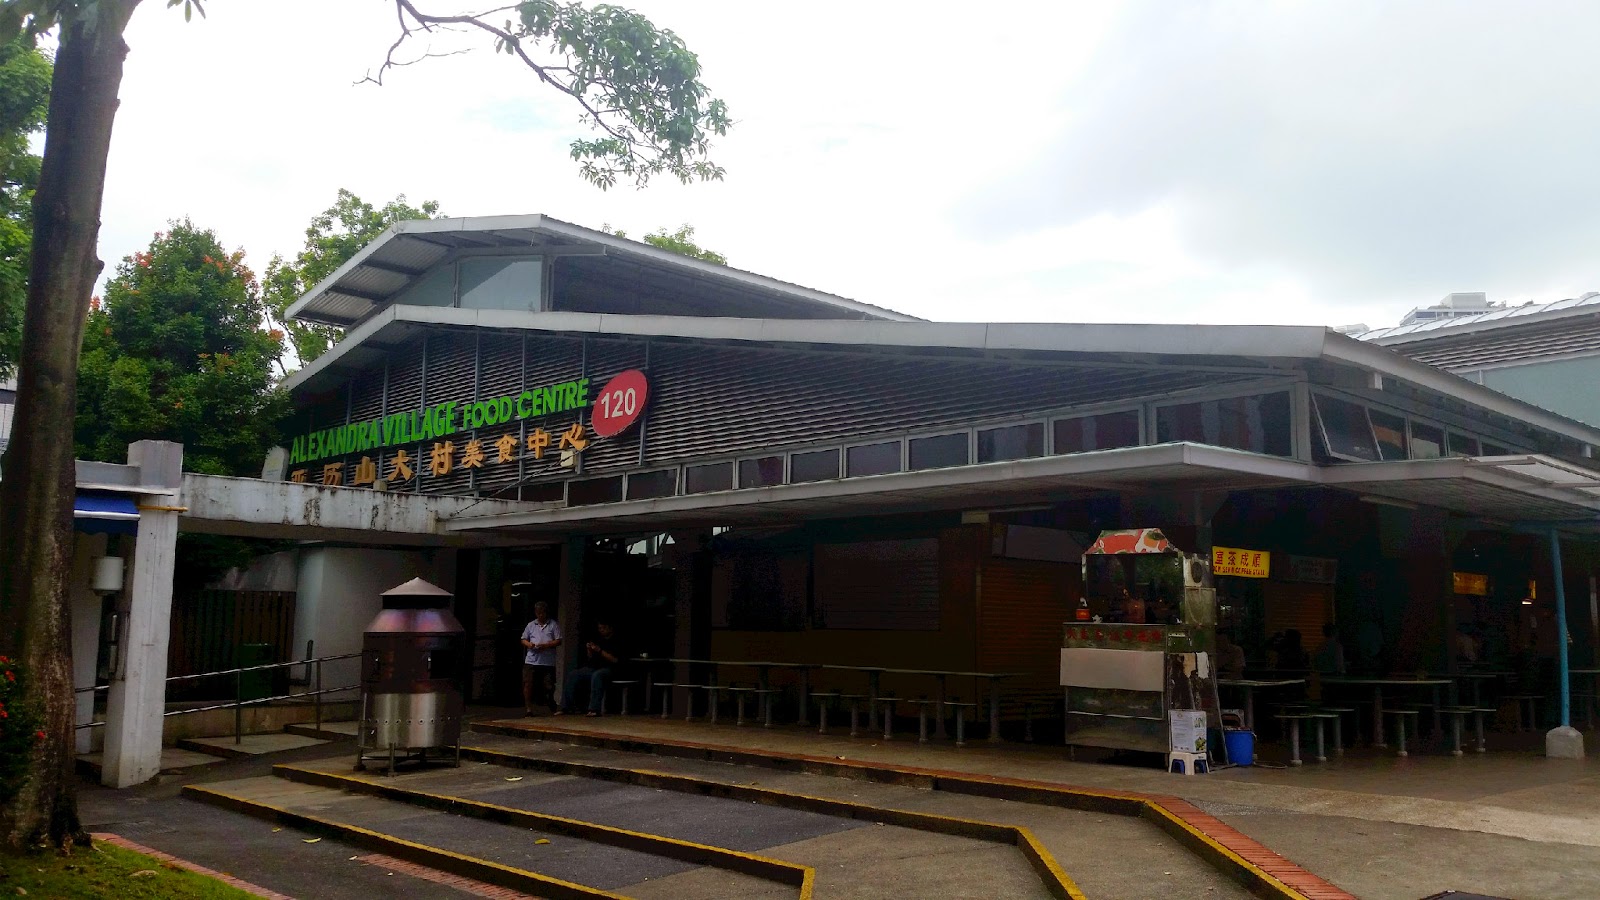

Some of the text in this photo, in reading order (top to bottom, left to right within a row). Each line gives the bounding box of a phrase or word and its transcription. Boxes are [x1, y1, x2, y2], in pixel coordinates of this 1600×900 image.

[290, 378, 590, 464] ALEXANDRA VILLAGE FOOD CENTRE
[600, 387, 636, 419] 120
